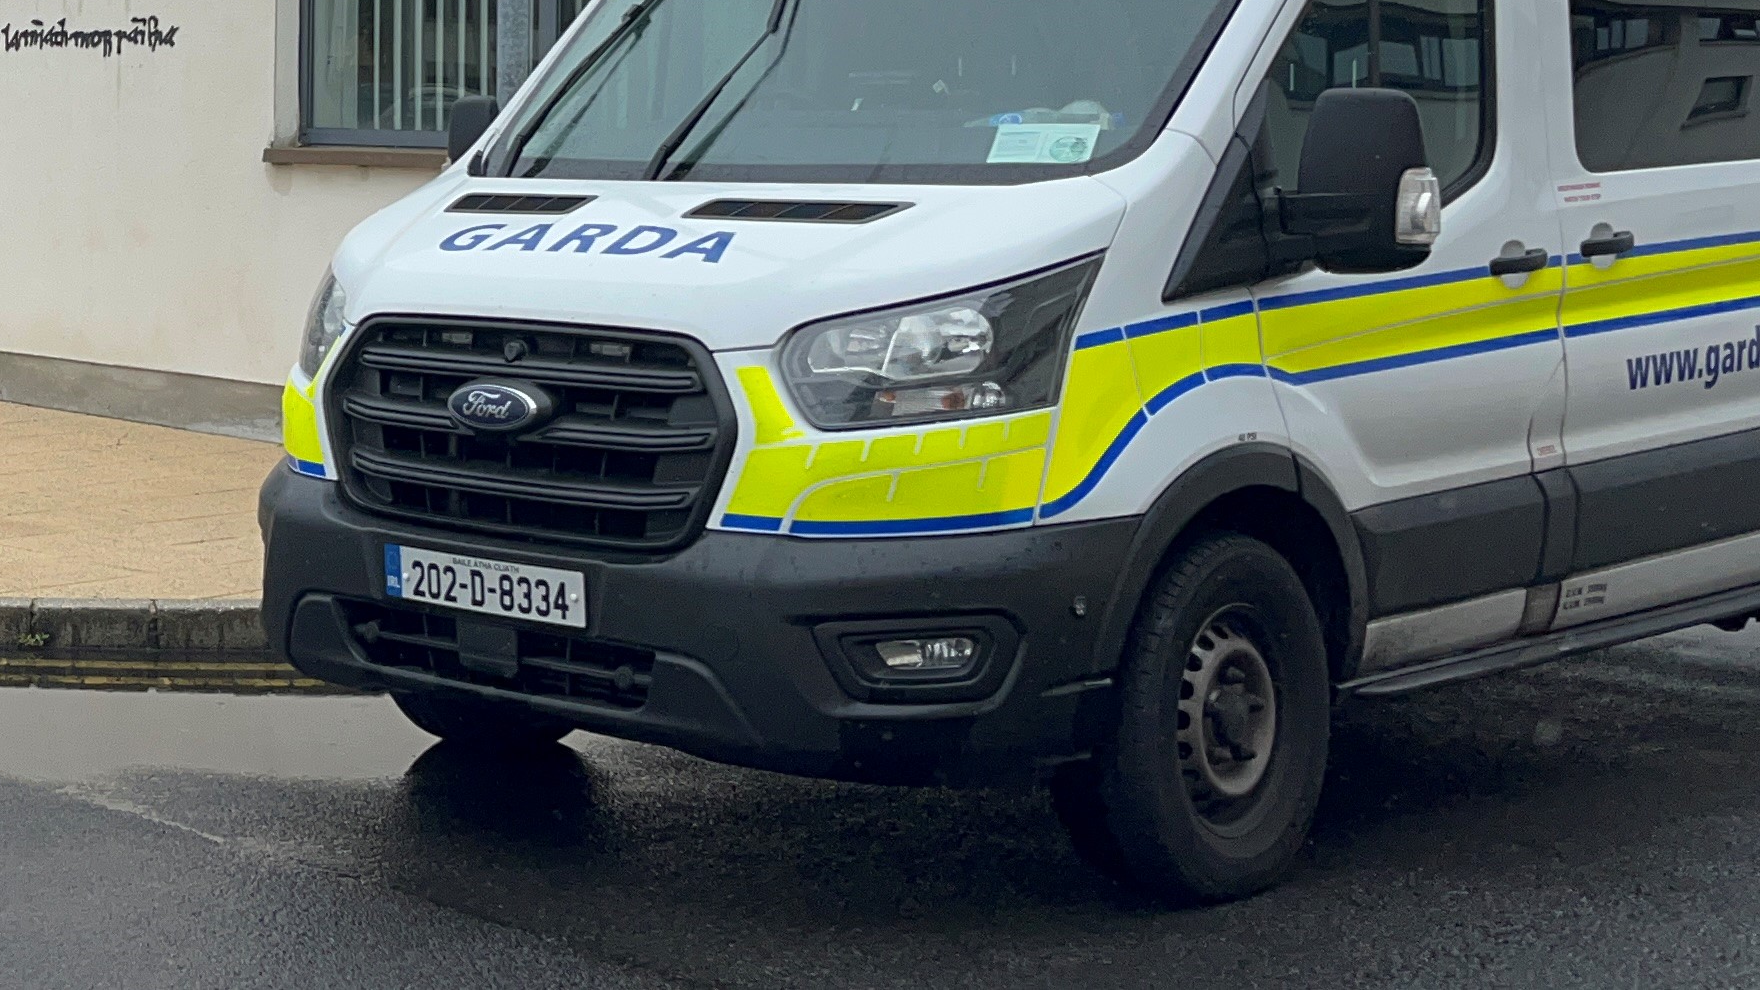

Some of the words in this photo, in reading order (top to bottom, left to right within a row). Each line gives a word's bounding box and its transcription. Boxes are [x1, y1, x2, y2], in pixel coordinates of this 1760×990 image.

[440, 223, 736, 264] GARDA
[1626, 324, 1760, 390] www.gard
[462, 390, 513, 420] Ford
[411, 560, 570, 621] 202-D-8334
